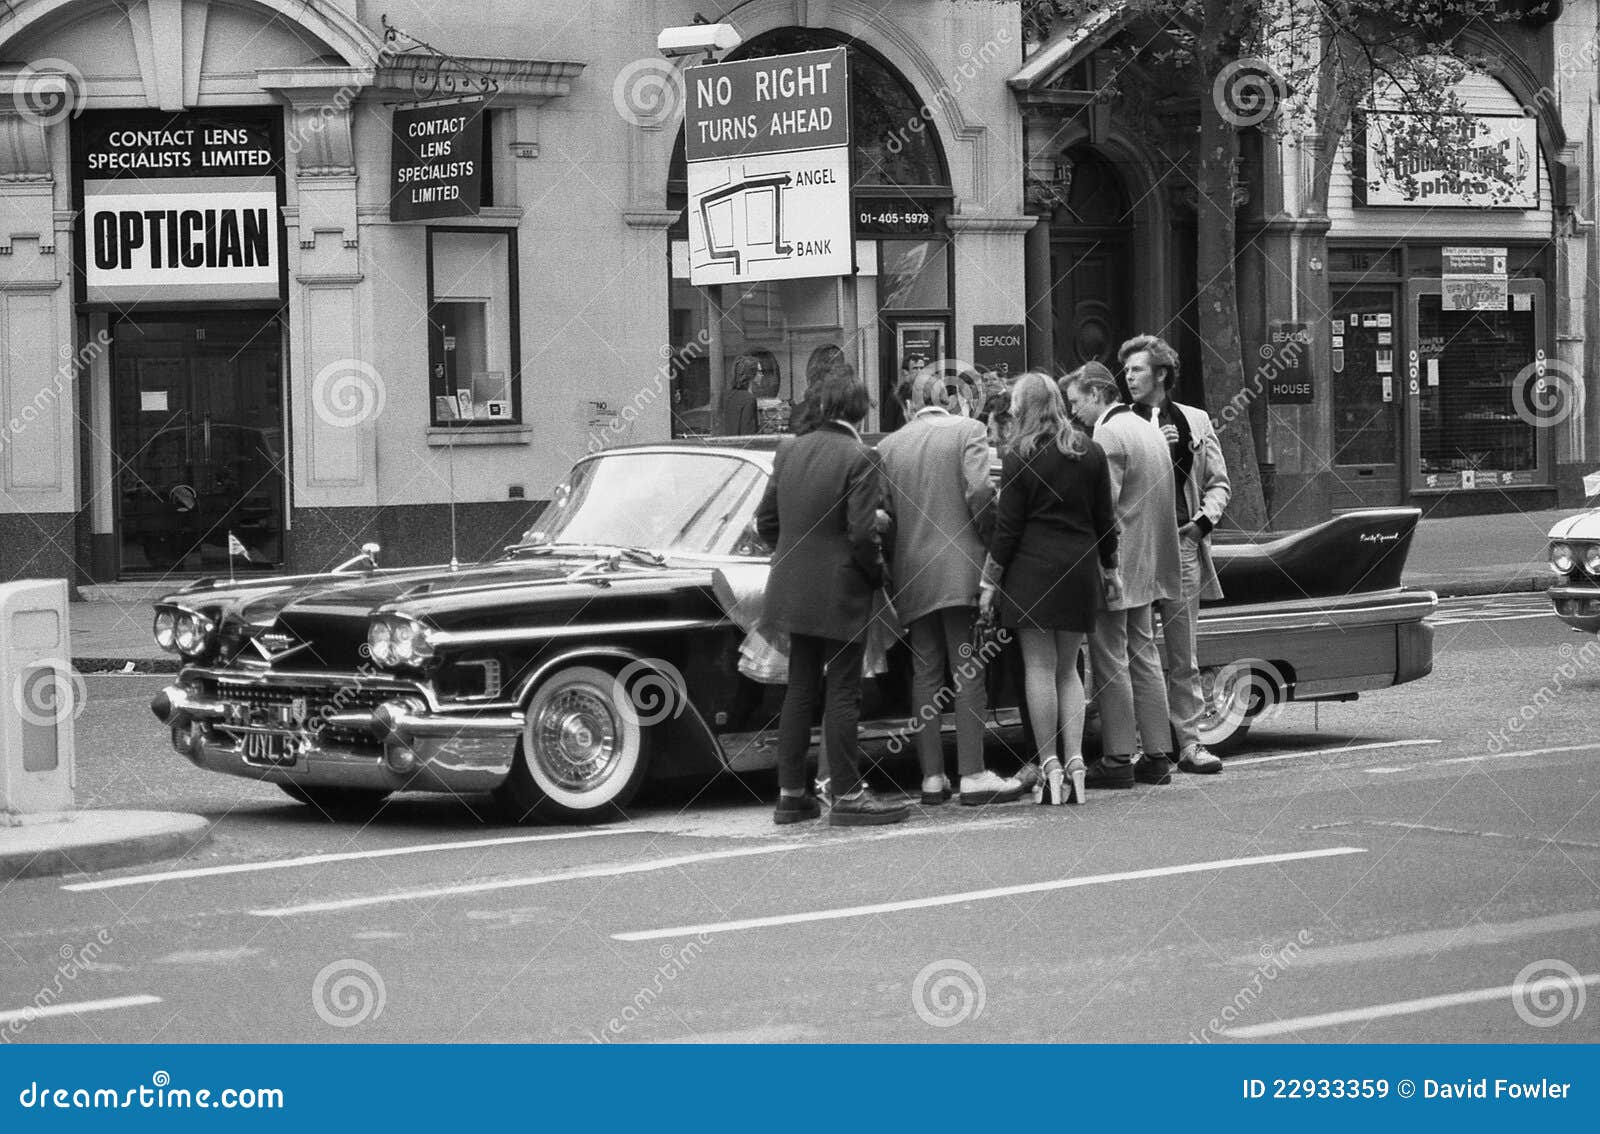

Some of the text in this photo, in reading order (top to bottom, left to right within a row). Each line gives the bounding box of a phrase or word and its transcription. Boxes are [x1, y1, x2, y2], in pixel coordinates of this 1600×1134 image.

[697, 63, 832, 109] NO RIGHT
[409, 117, 466, 137] CONTACT
[698, 107, 833, 143] TURNS AHEAD
[109, 129, 248, 147] CONTACT LENS
[420, 140, 451, 158] LENS
[88, 150, 271, 169] SPECIALISTS LIMITED
[398, 161, 474, 183] SPECIALISTS
[795, 168, 836, 187] ANGEL
[412, 185, 460, 203] LIMITED
[860, 213, 929, 224] 01-405-5979
[93, 208, 269, 270] OPTICIAN
[797, 239, 832, 257] BANK
[979, 335, 1020, 346] BEACON
[1273, 384, 1310, 394] HOUSE
[249, 733, 279, 758] UYL
